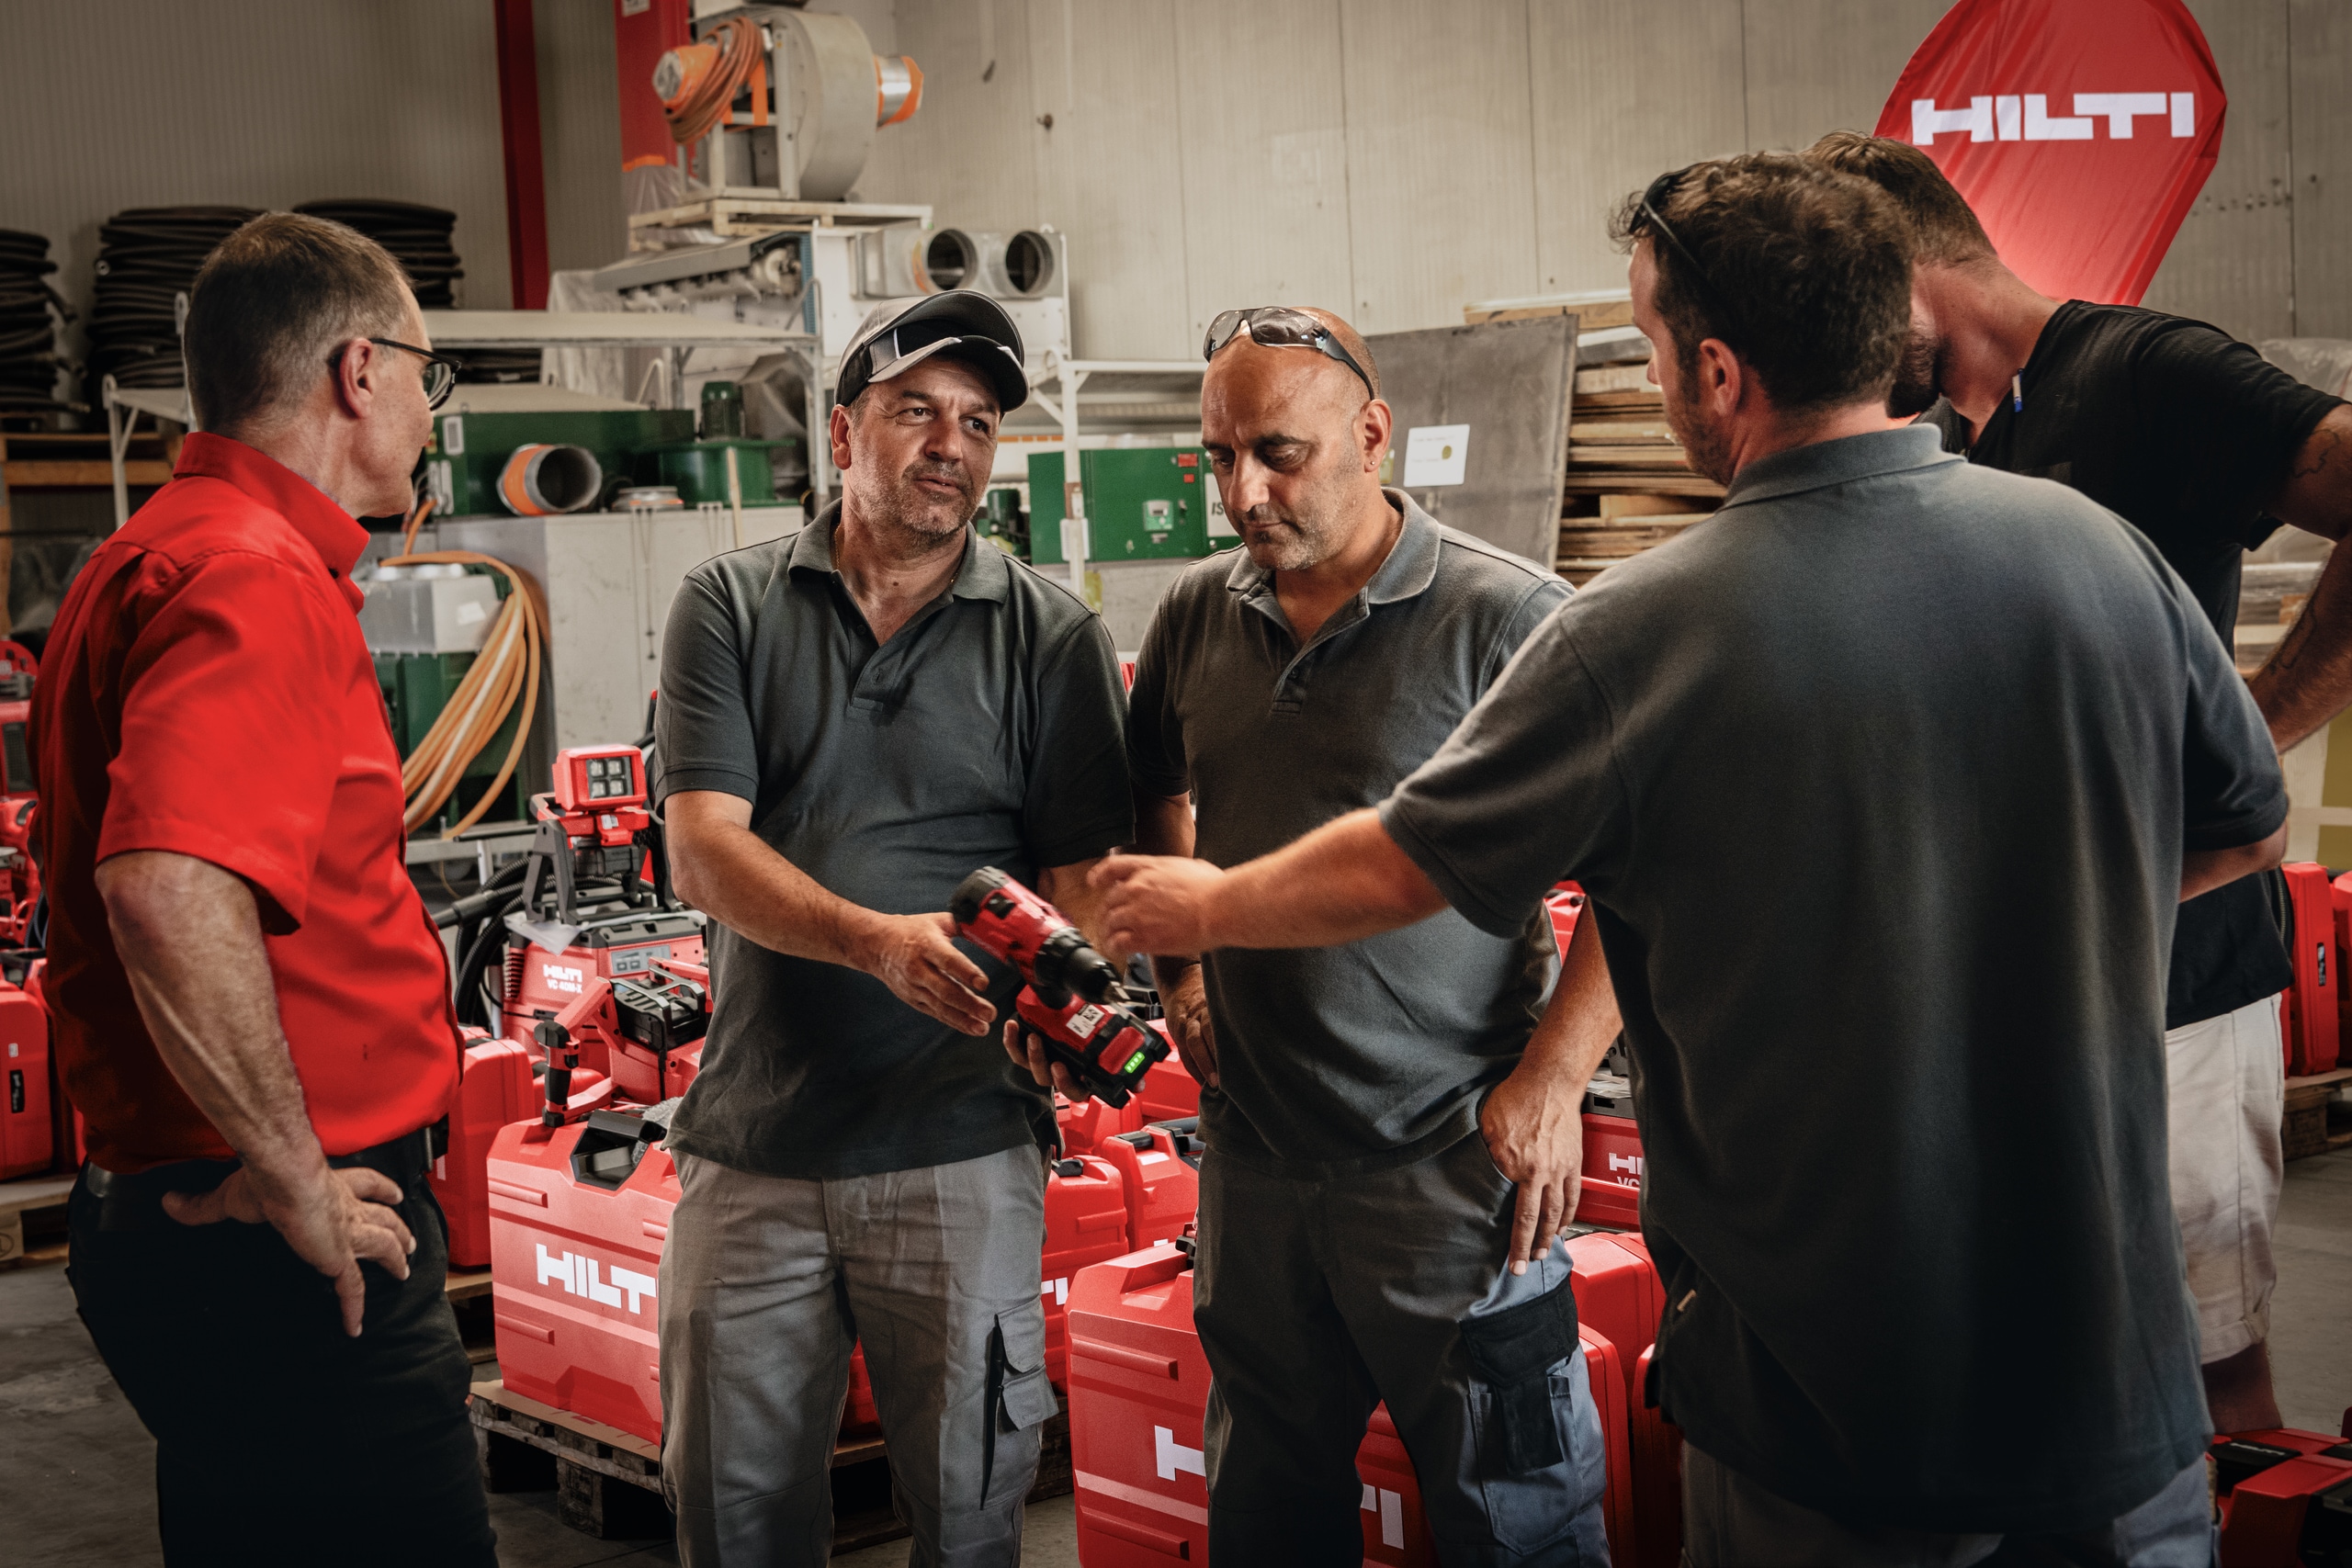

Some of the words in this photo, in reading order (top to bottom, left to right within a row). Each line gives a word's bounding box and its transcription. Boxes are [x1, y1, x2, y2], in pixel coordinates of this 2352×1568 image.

[1912, 93, 2195, 145] HILTI
[1212, 502, 1225, 515] IS
[543, 964, 582, 982] HILTI
[547, 978, 559, 989] VC
[537, 1243, 657, 1314] HILT
